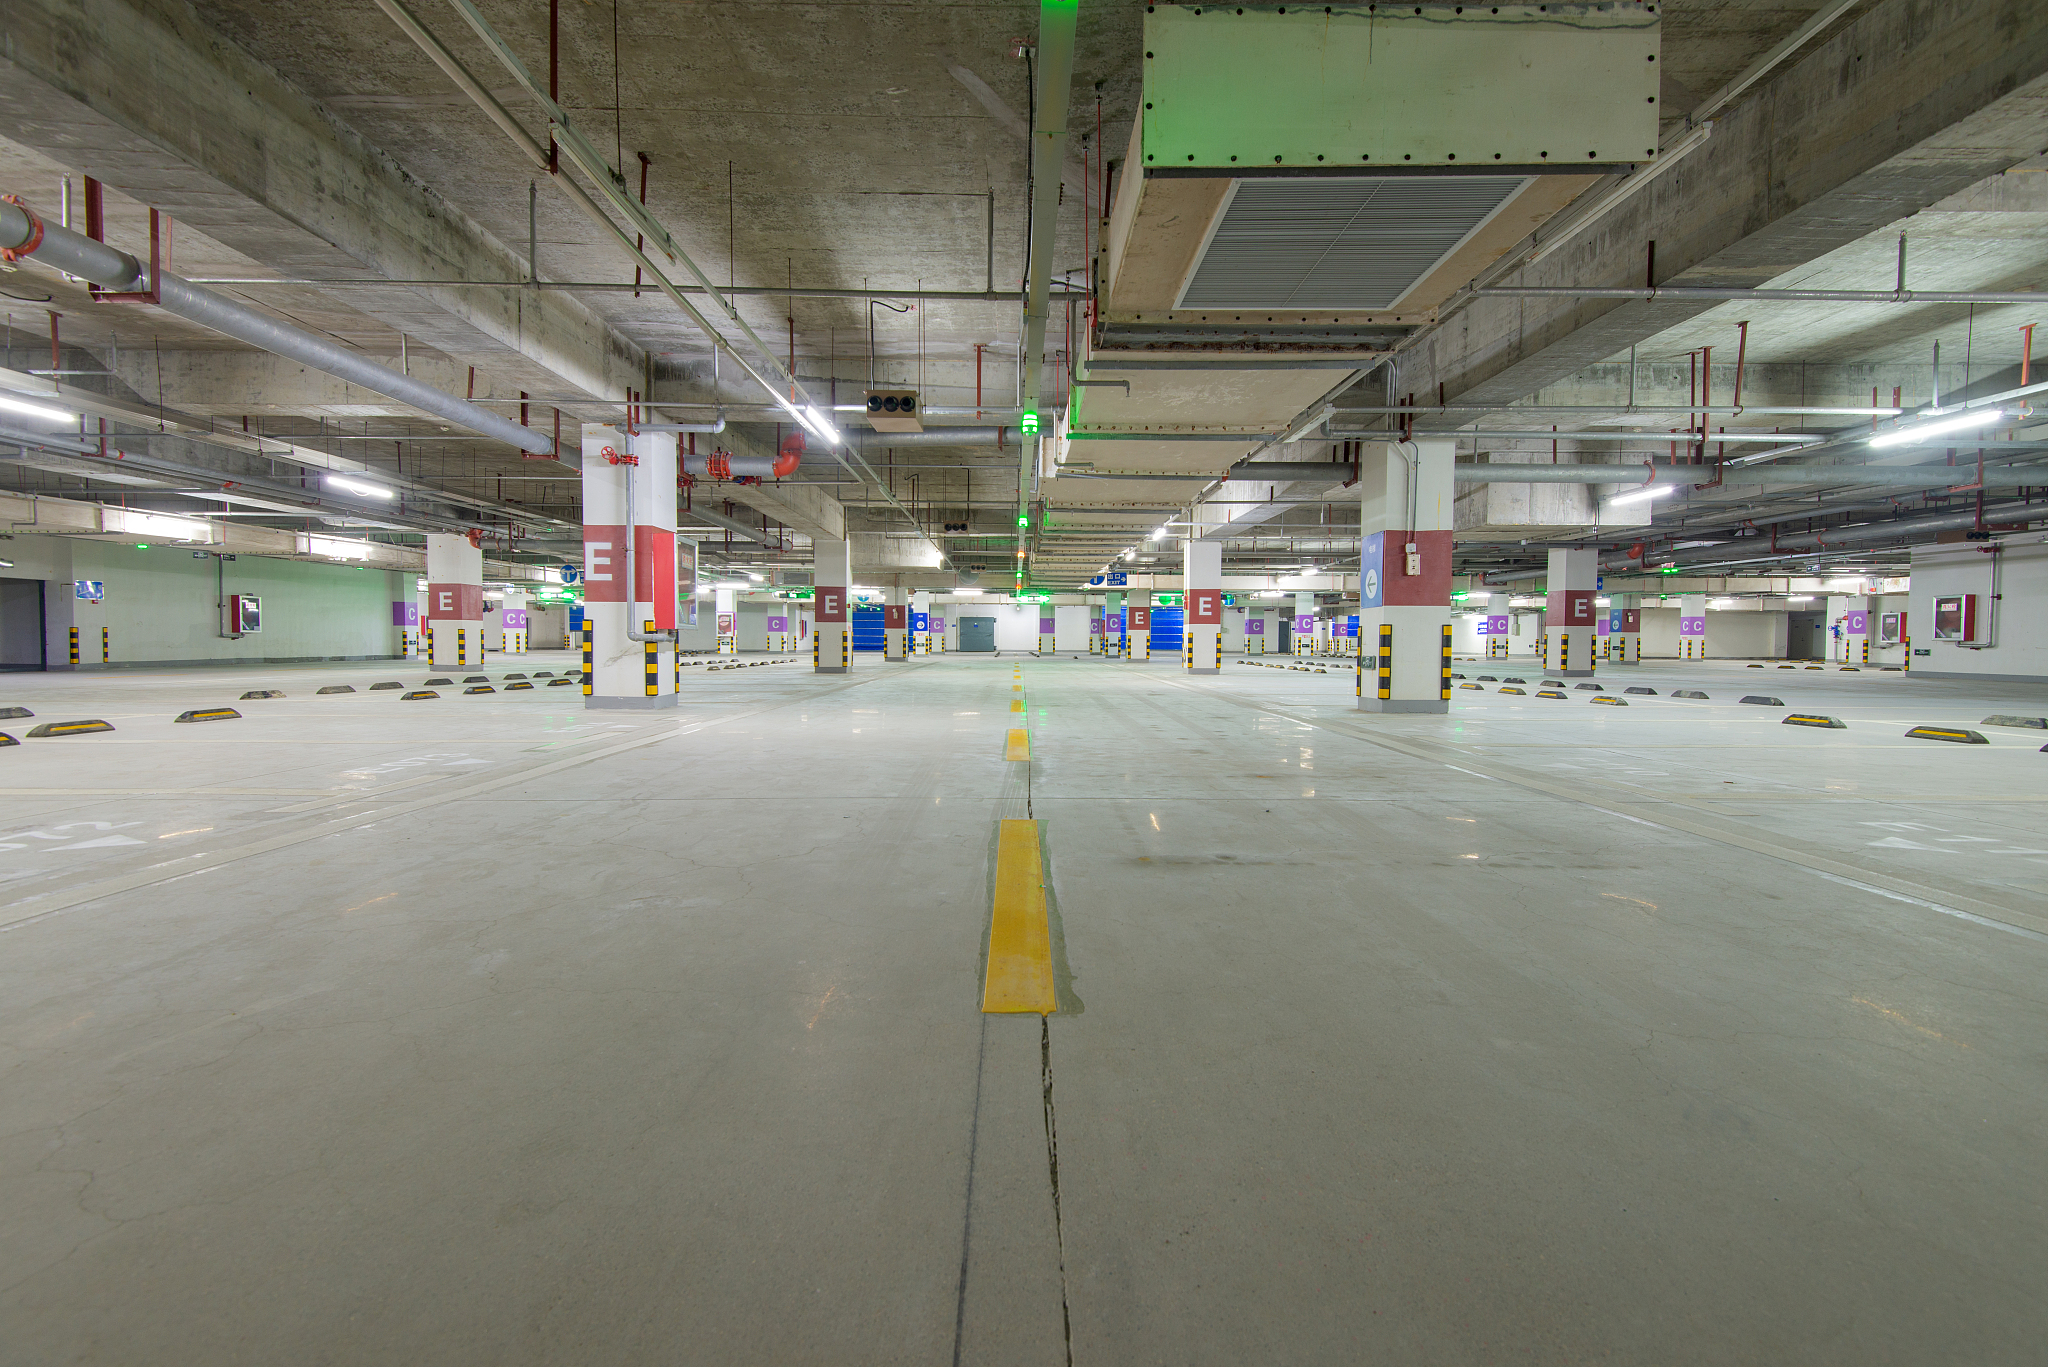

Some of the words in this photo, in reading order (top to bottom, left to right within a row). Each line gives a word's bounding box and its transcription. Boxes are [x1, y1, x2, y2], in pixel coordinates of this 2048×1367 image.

[584, 542, 612, 581] E
[439, 592, 453, 611] E
[825, 595, 838, 614] E
[1199, 597, 1212, 616] E
[408, 607, 416, 621] C
[1575, 599, 1588, 618] E
[506, 613, 516, 624] C
[519, 613, 525, 625] C
[1109, 618, 1118, 628] C
[1135, 612, 1144, 624] E
[1302, 618, 1311, 629] C
[1852, 616, 1863, 629] C
[772, 620, 780, 629] C
[933, 621, 941, 629] C
[1091, 622, 1098, 631] C
[1253, 622, 1260, 631] C
[1340, 626, 1347, 634] C
[1488, 619, 1494, 630] C
[1497, 619, 1506, 630] C
[1682, 621, 1689, 631] C
[1693, 621, 1703, 632] C
